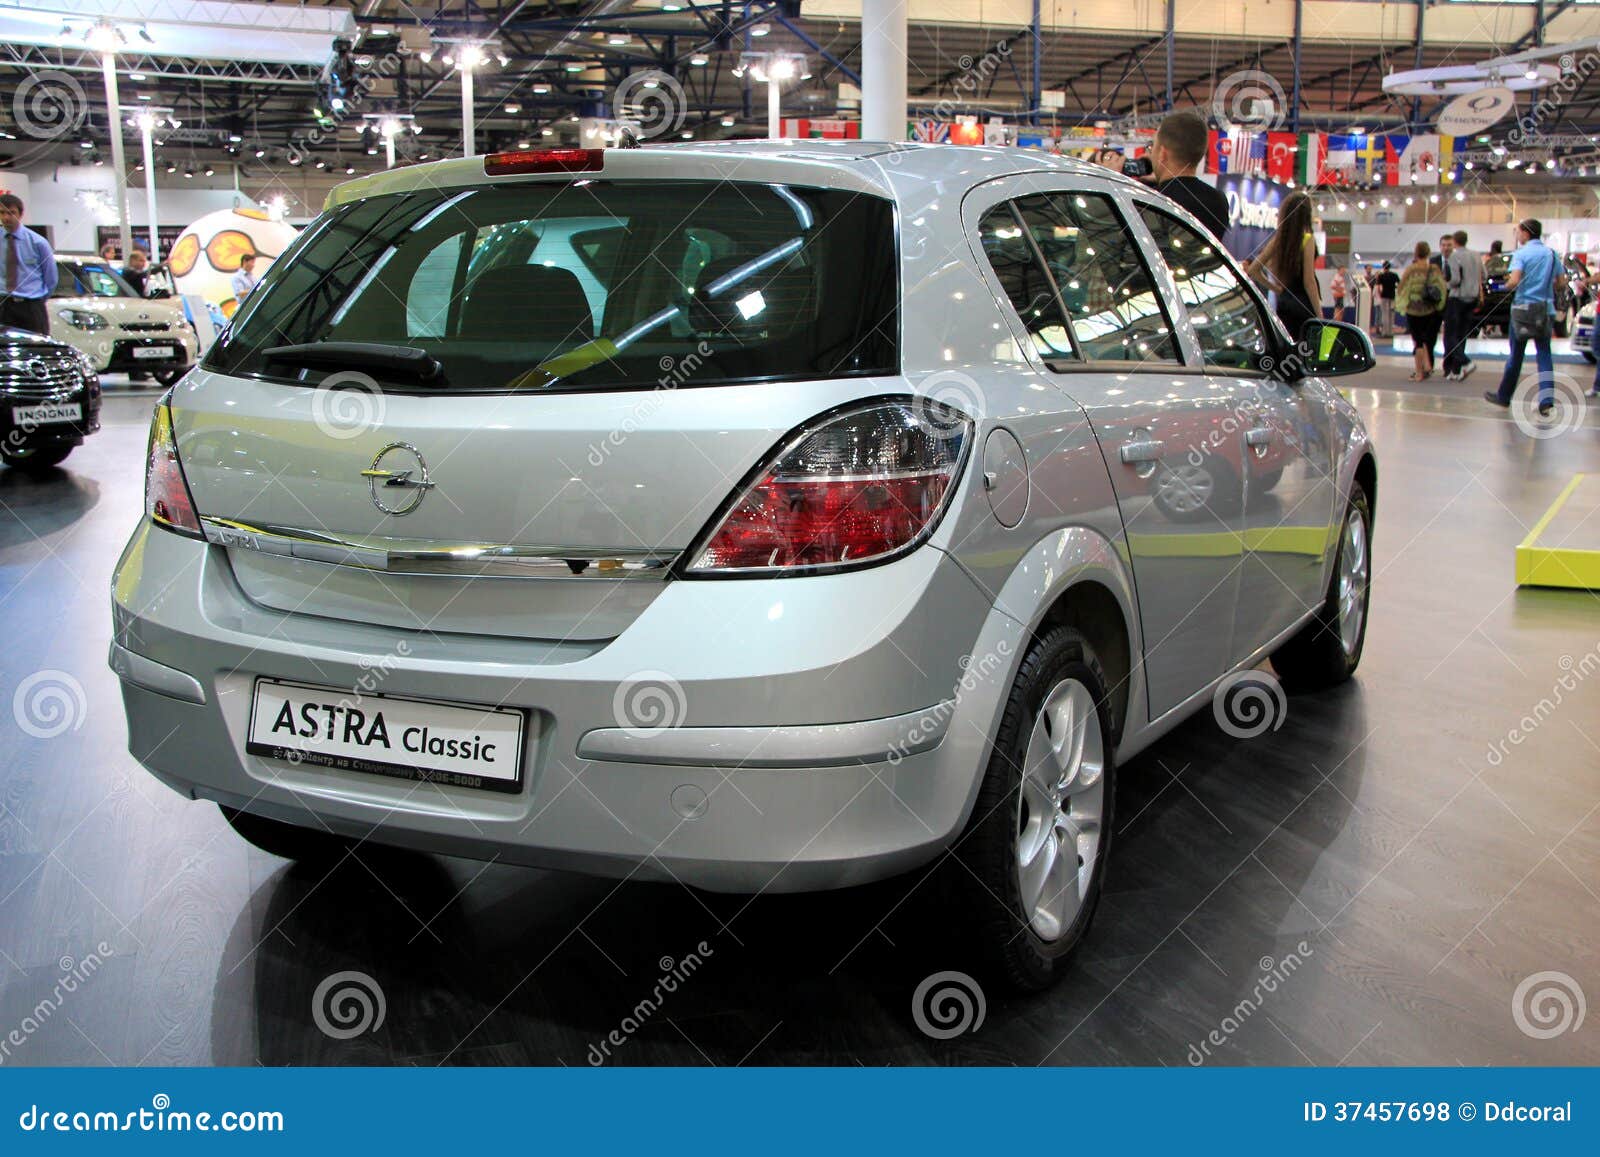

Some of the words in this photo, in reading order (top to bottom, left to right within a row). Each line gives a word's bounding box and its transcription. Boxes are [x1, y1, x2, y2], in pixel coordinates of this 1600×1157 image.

[19, 408, 77, 421] INSIGNIA
[271, 699, 391, 749] ASTRA
[402, 727, 496, 763] Classic
